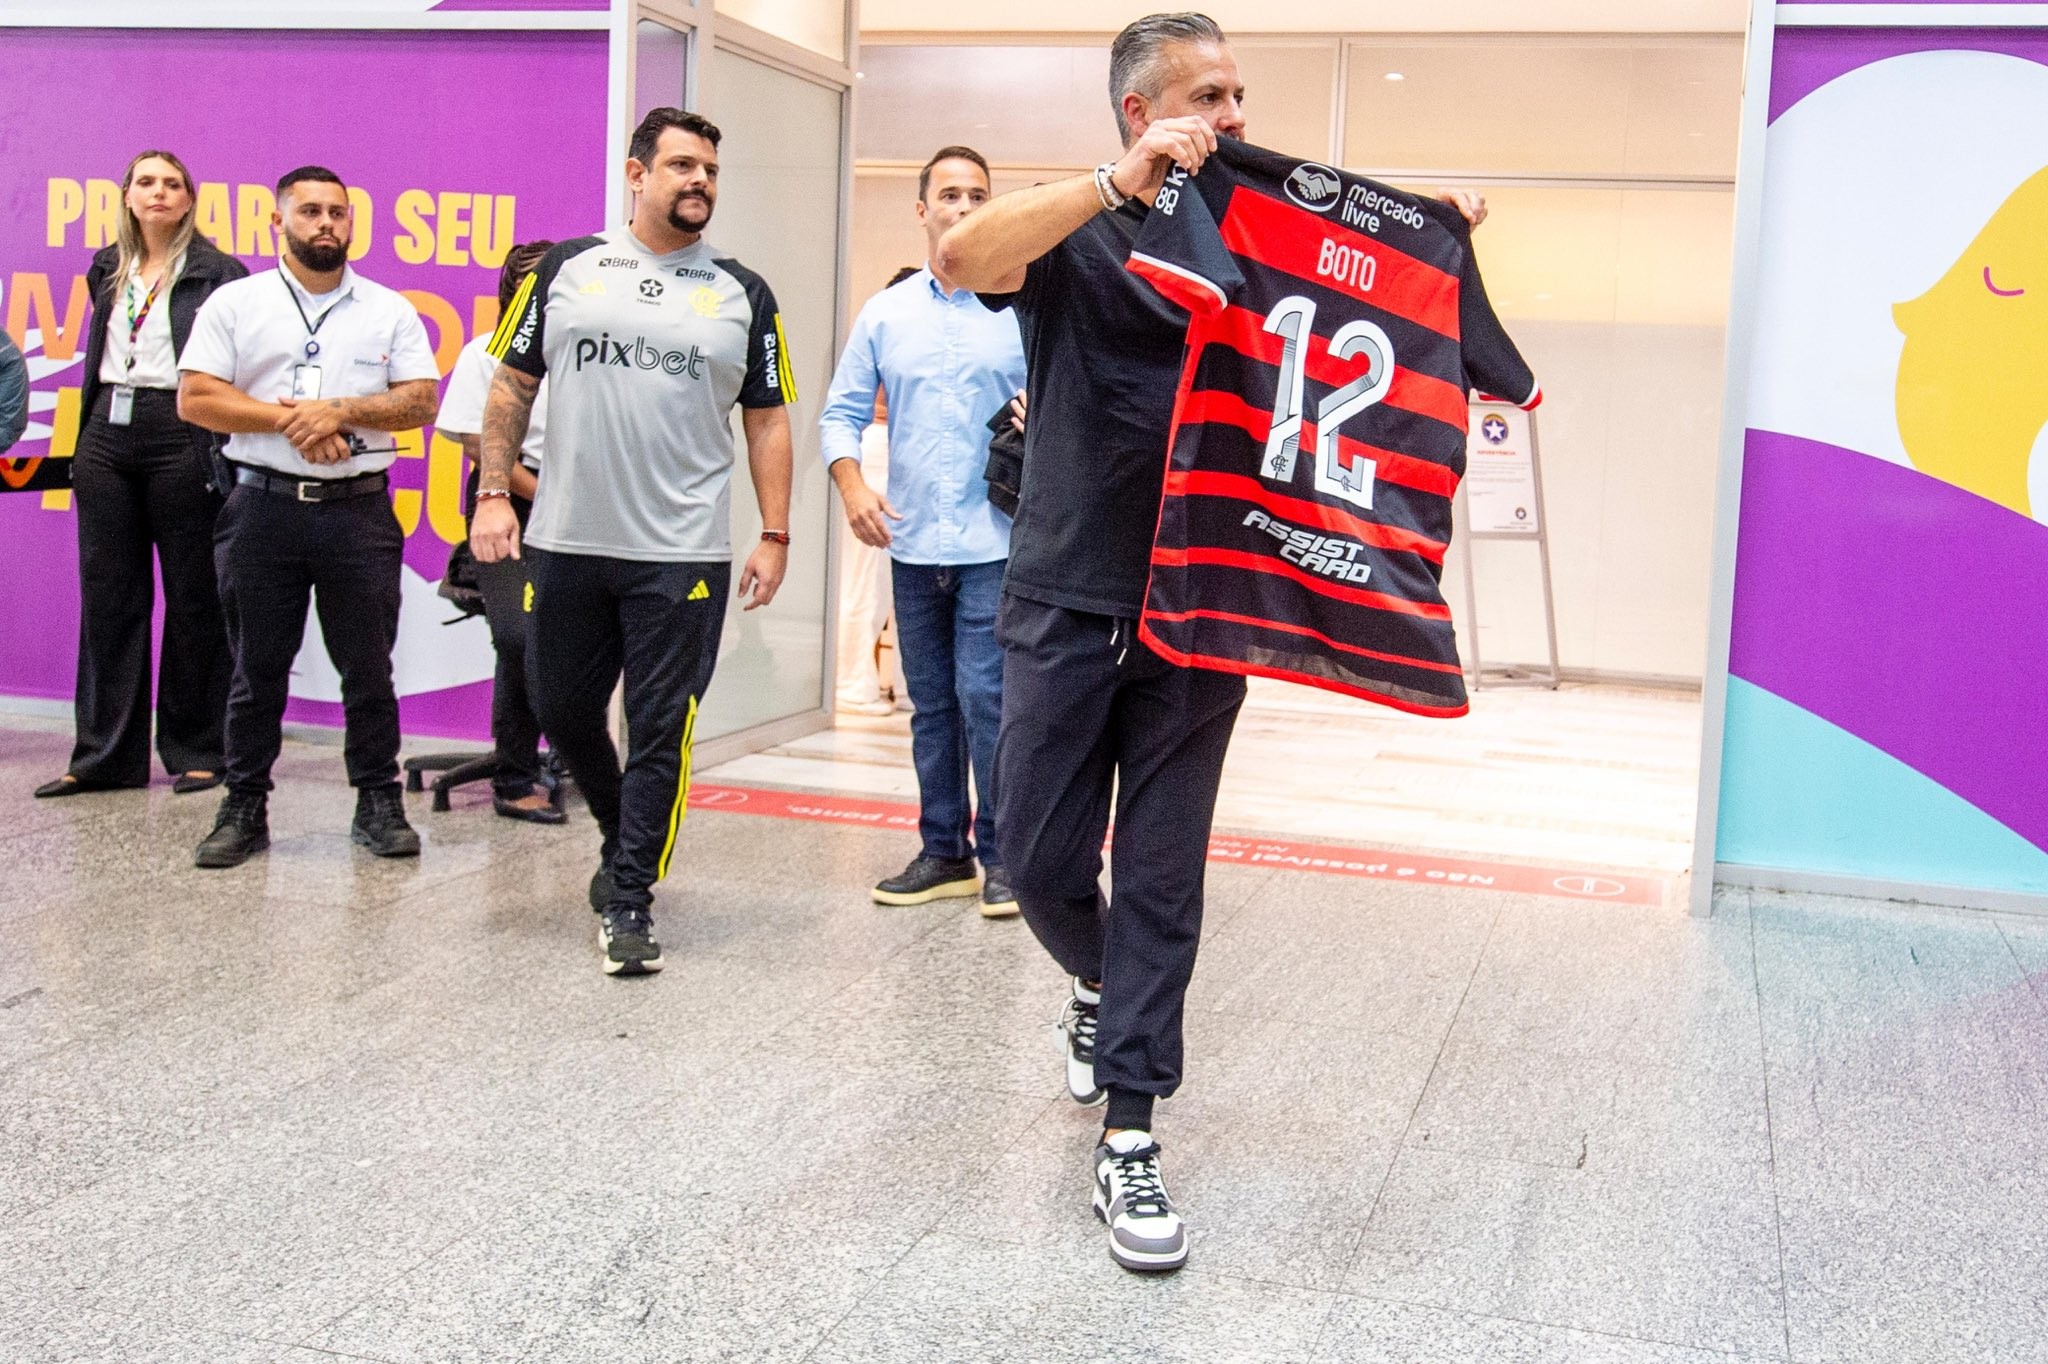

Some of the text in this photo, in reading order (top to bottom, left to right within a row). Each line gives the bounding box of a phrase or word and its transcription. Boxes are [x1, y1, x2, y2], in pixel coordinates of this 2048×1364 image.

[46, 177, 288, 258] PRAR
[394, 189, 516, 269] SEU
[1341, 199, 1380, 233] livre
[1347, 184, 1424, 230] mercado
[611, 257, 639, 270] BRB
[689, 269, 716, 281] BRB
[1316, 237, 1377, 292] BOTO
[576, 332, 705, 380] pixbet
[1260, 295, 1396, 511] 12
[1242, 510, 1364, 561] ASSIST
[1279, 544, 1372, 584] CARD
[1425, 870, 1495, 885] Não
